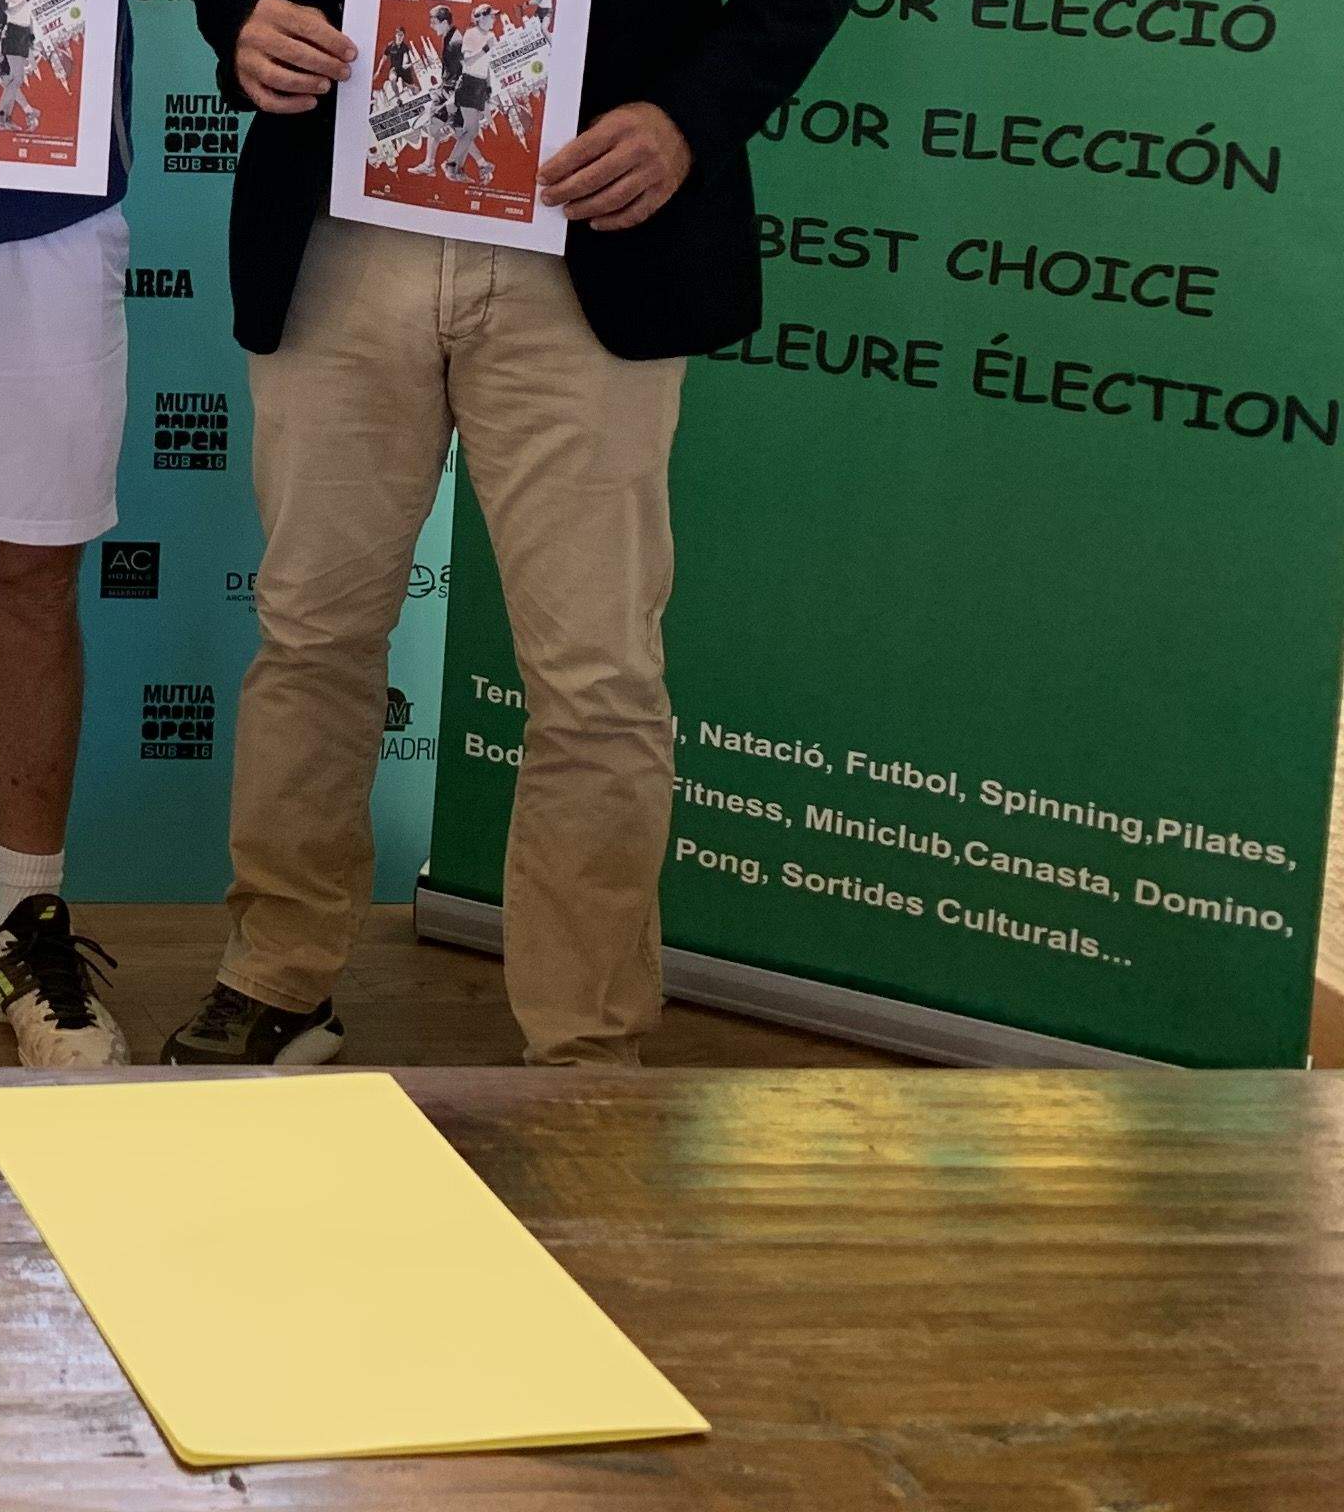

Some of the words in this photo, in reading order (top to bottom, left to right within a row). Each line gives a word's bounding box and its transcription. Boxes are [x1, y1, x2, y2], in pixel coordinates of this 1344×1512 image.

[164, 132, 238, 153] OPEN
[165, 116, 239, 131] MADRID
[922, 108, 1282, 194] ELECCIÓN
[758, 213, 919, 274] BEST
[946, 238, 1220, 318] CHOICE
[155, 393, 228, 413] MUTUA
[973, 333, 1340, 446] ÉLECTION
[154, 430, 228, 451] OPEN
[155, 414, 228, 429] MADRID
[143, 684, 215, 704] MUTUA
[470, 674, 524, 709] Ten
[700, 721, 834, 775] Natació,
[845, 750, 967, 804] Futbol,
[465, 732, 524, 767] Bod
[1135, 878, 1295, 938] Domino,
[676, 837, 770, 885] Pong,
[781, 861, 925, 917] Sortides
